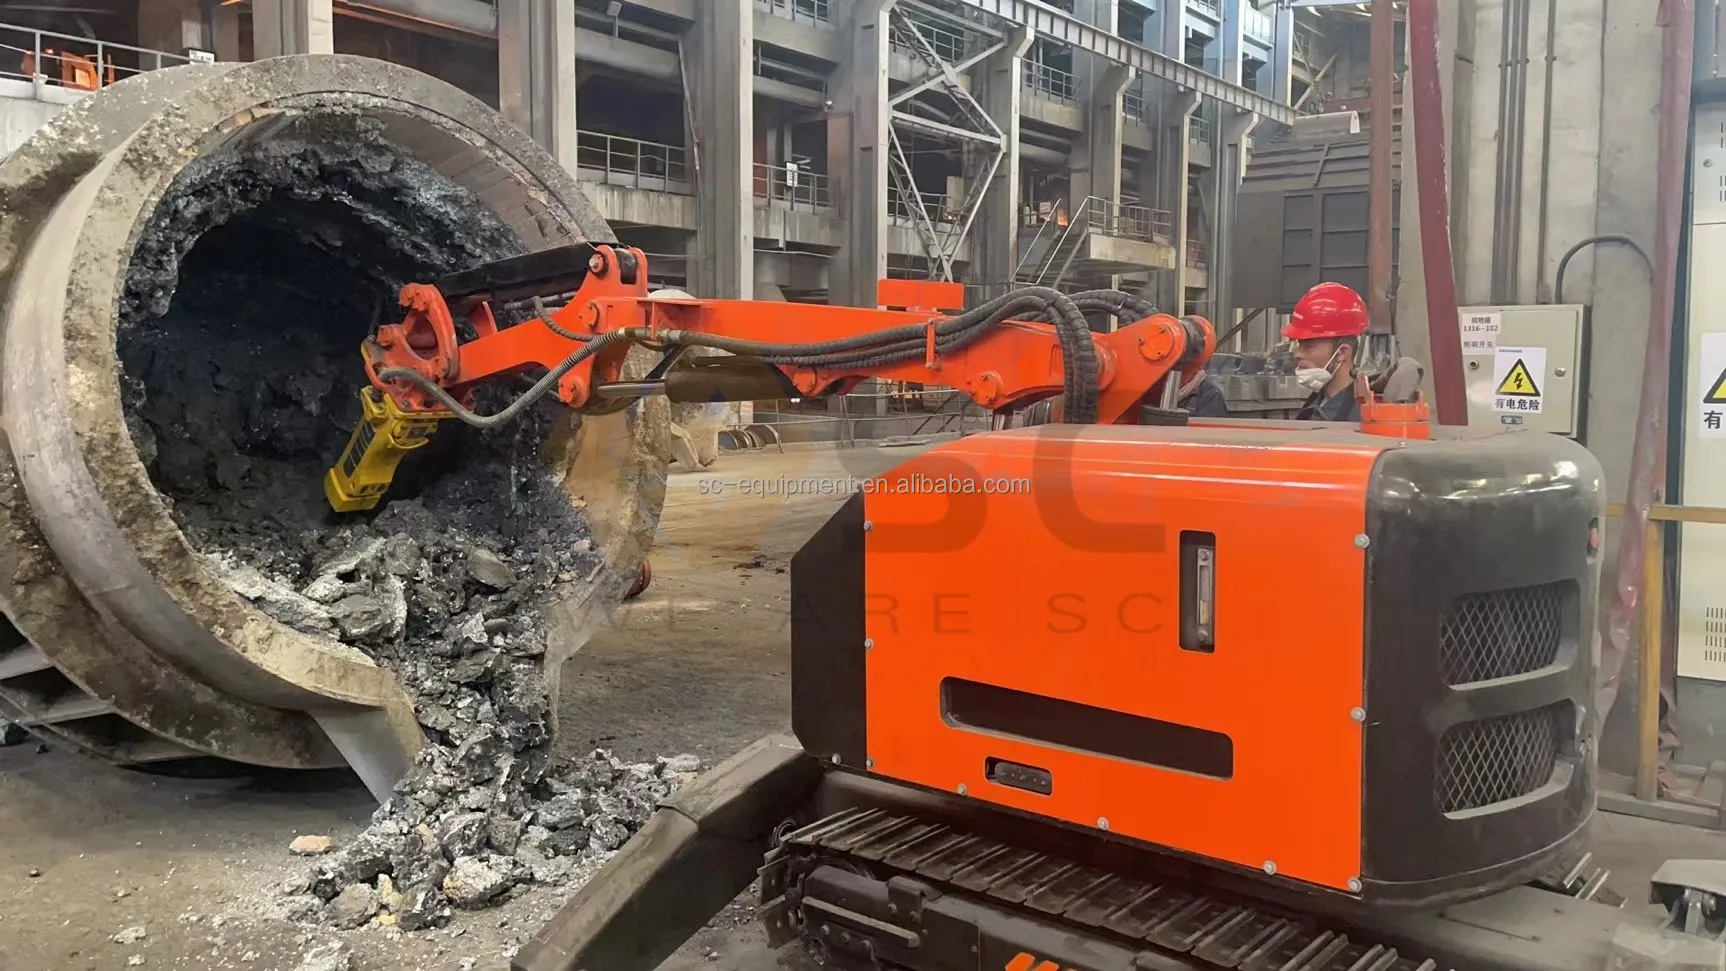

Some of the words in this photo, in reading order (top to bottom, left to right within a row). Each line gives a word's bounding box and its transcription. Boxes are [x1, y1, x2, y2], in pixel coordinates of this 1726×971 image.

[1495, 398, 1540, 410] 有电危险
[1703, 410, 1724, 430] 有
